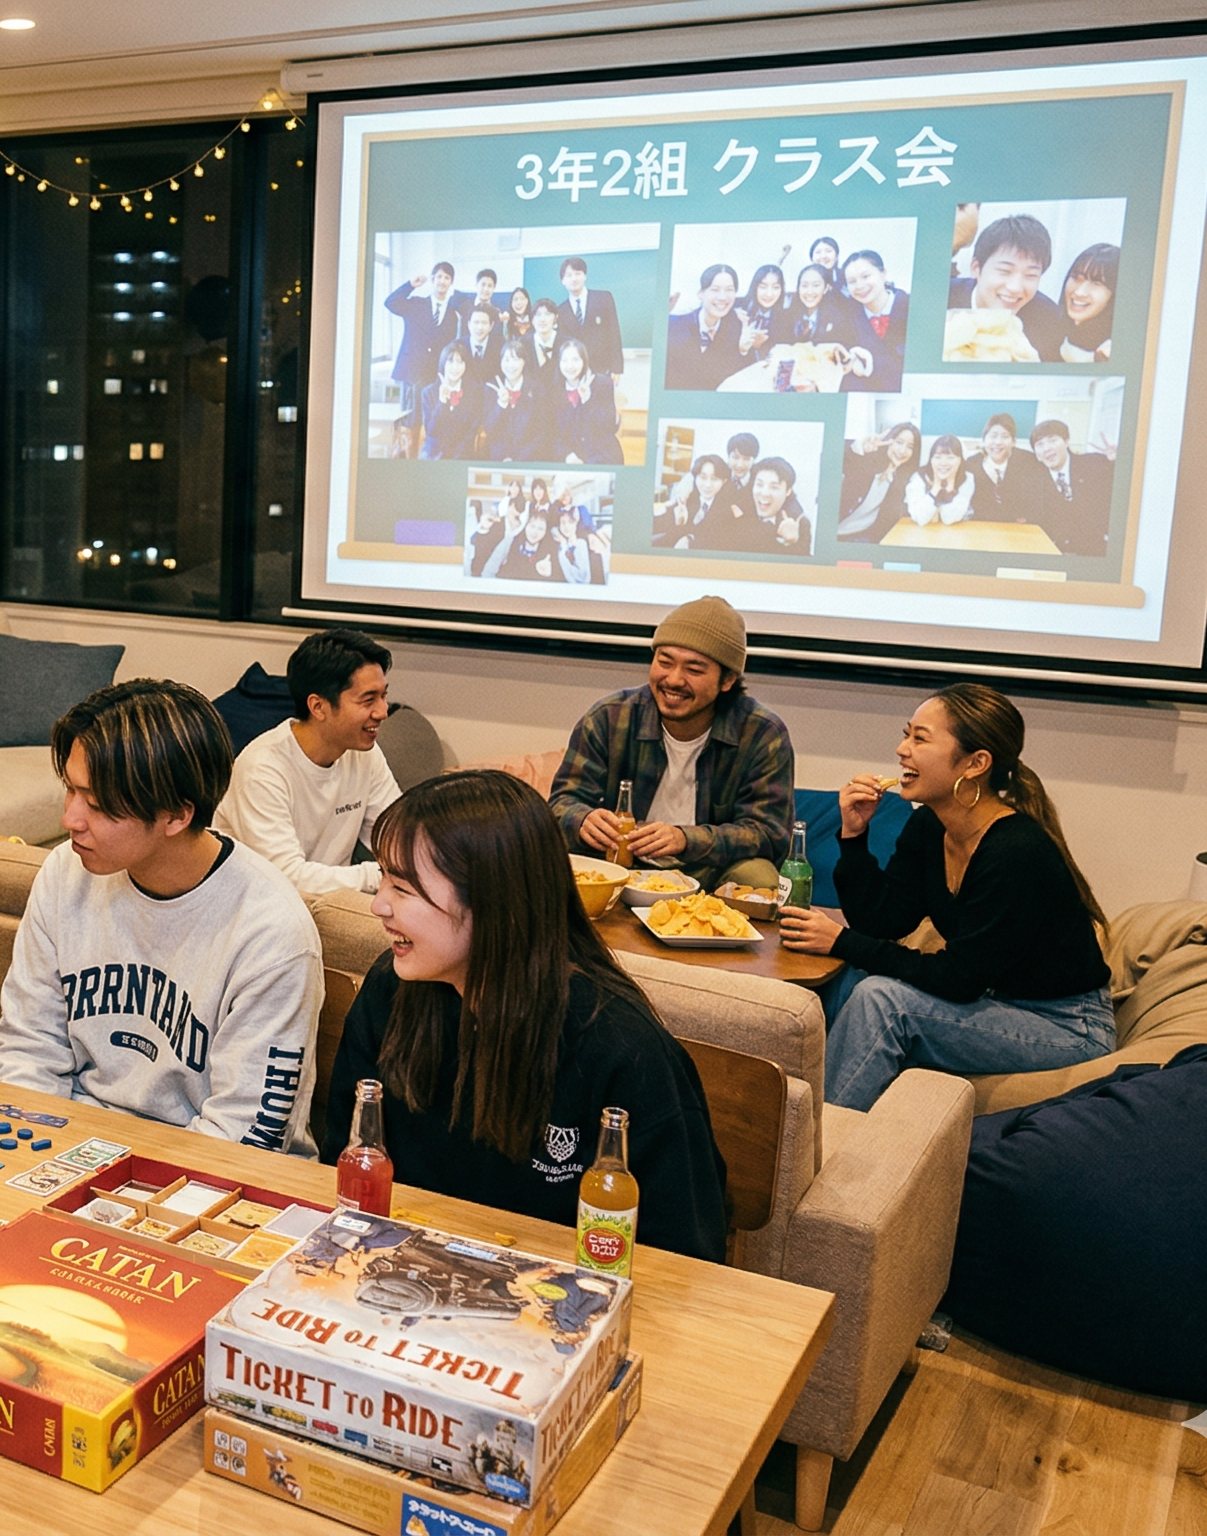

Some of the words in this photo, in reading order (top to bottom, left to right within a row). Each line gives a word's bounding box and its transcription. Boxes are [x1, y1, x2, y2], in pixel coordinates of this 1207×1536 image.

[514, 140, 689, 203] 3年2組
[712, 125, 959, 195] クラス会
[50, 1237, 202, 1299] CATAN
[251, 1298, 342, 1345] RIDE
[219, 1342, 337, 1411] TICKET
[381, 1389, 464, 1451] RIDE
[382, 1338, 526, 1400] TICKET
